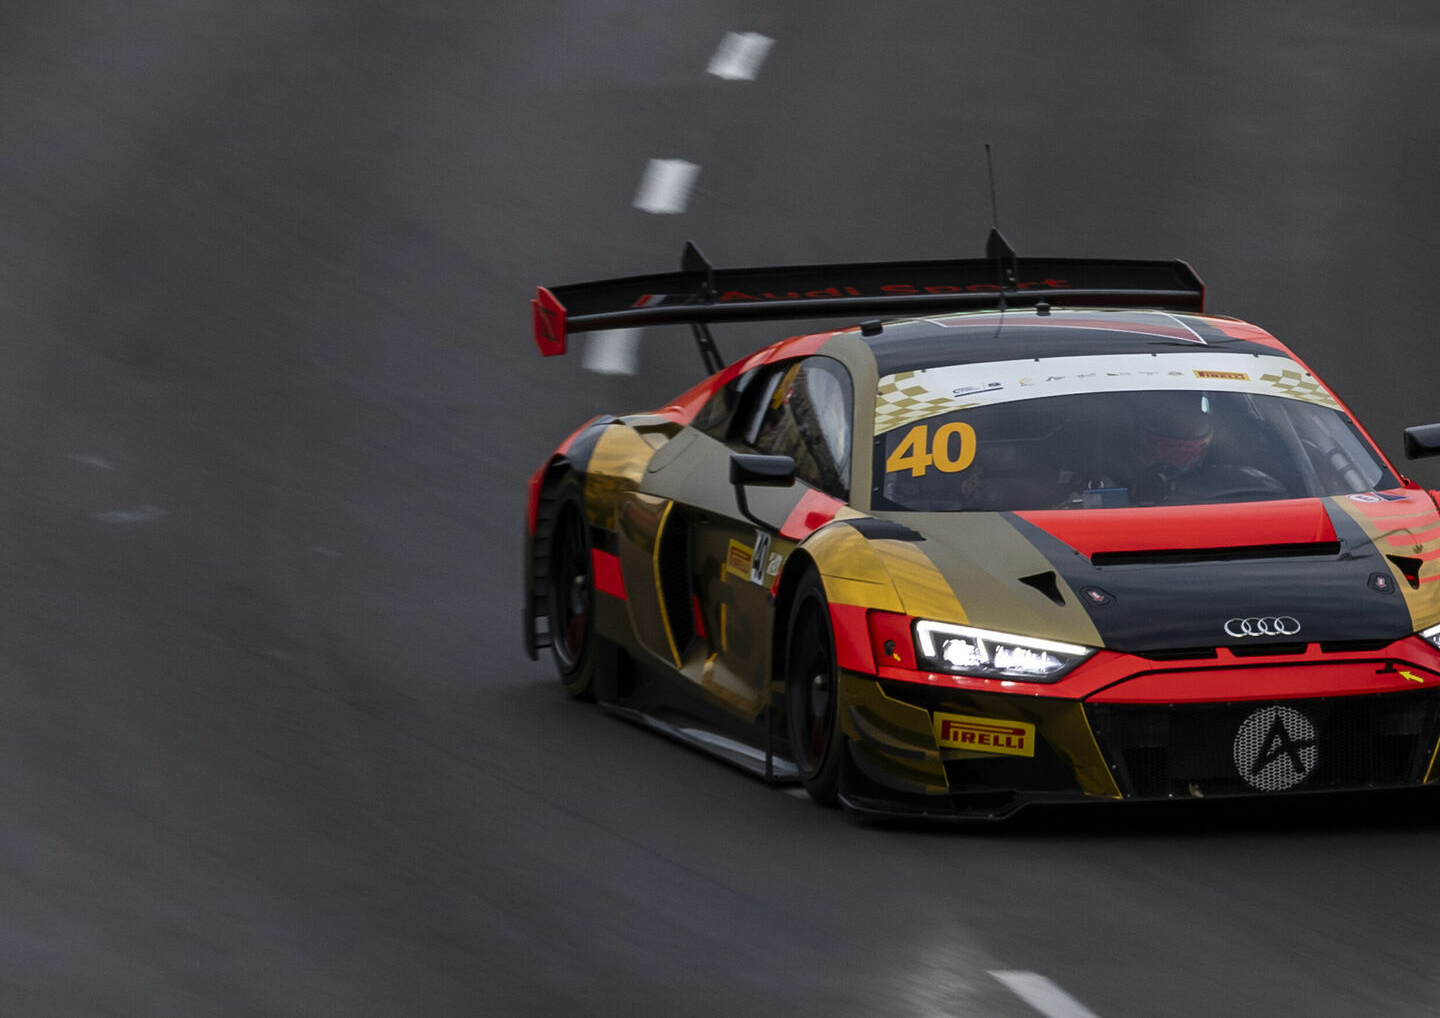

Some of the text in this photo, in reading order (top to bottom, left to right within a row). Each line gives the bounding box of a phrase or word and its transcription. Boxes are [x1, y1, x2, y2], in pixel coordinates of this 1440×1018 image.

[719, 278, 1072, 302] Audi Sport
[886, 422, 977, 477] 40
[940, 719, 1026, 750] PIRELLI
